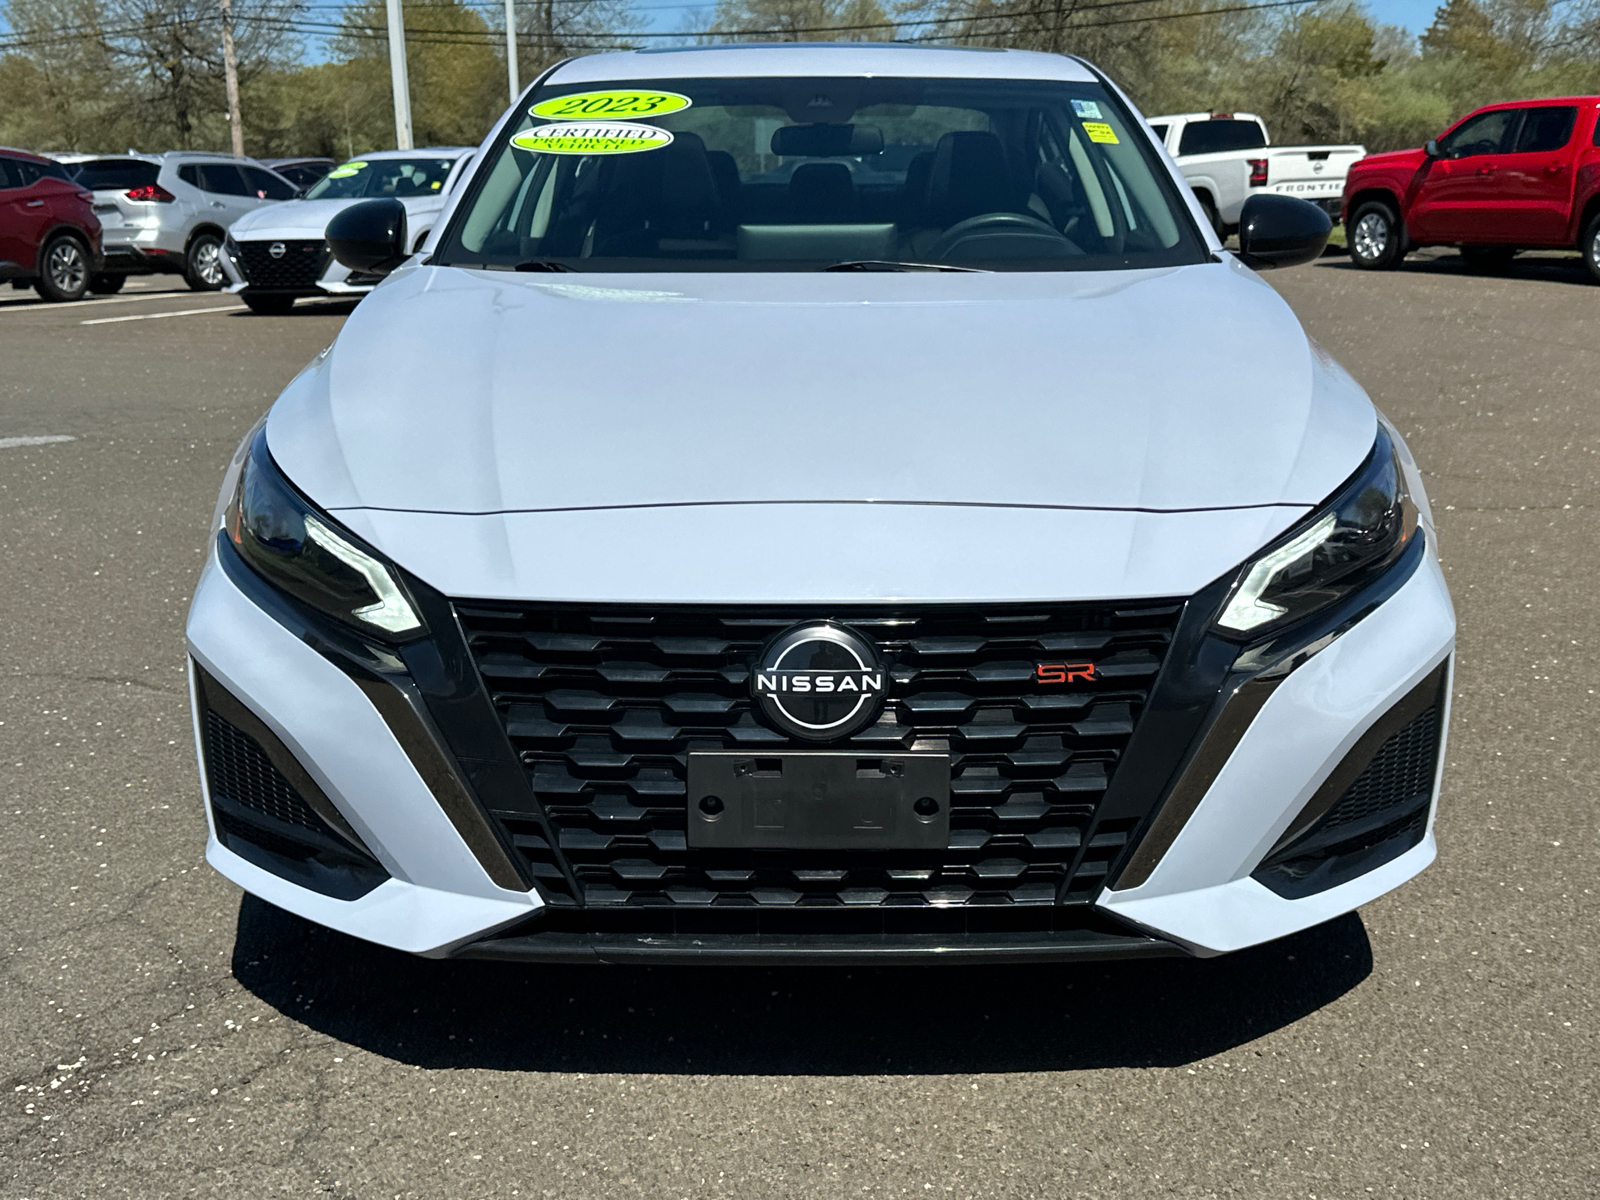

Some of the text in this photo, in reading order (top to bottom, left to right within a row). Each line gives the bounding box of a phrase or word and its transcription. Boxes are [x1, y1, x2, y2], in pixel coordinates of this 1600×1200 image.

[553, 96, 667, 115] 2023
[533, 128, 657, 139] CERTIFIED
[1275, 183, 1341, 193] FRONTIE
[1037, 663, 1096, 684] SR
[757, 674, 881, 692] NISSAN
